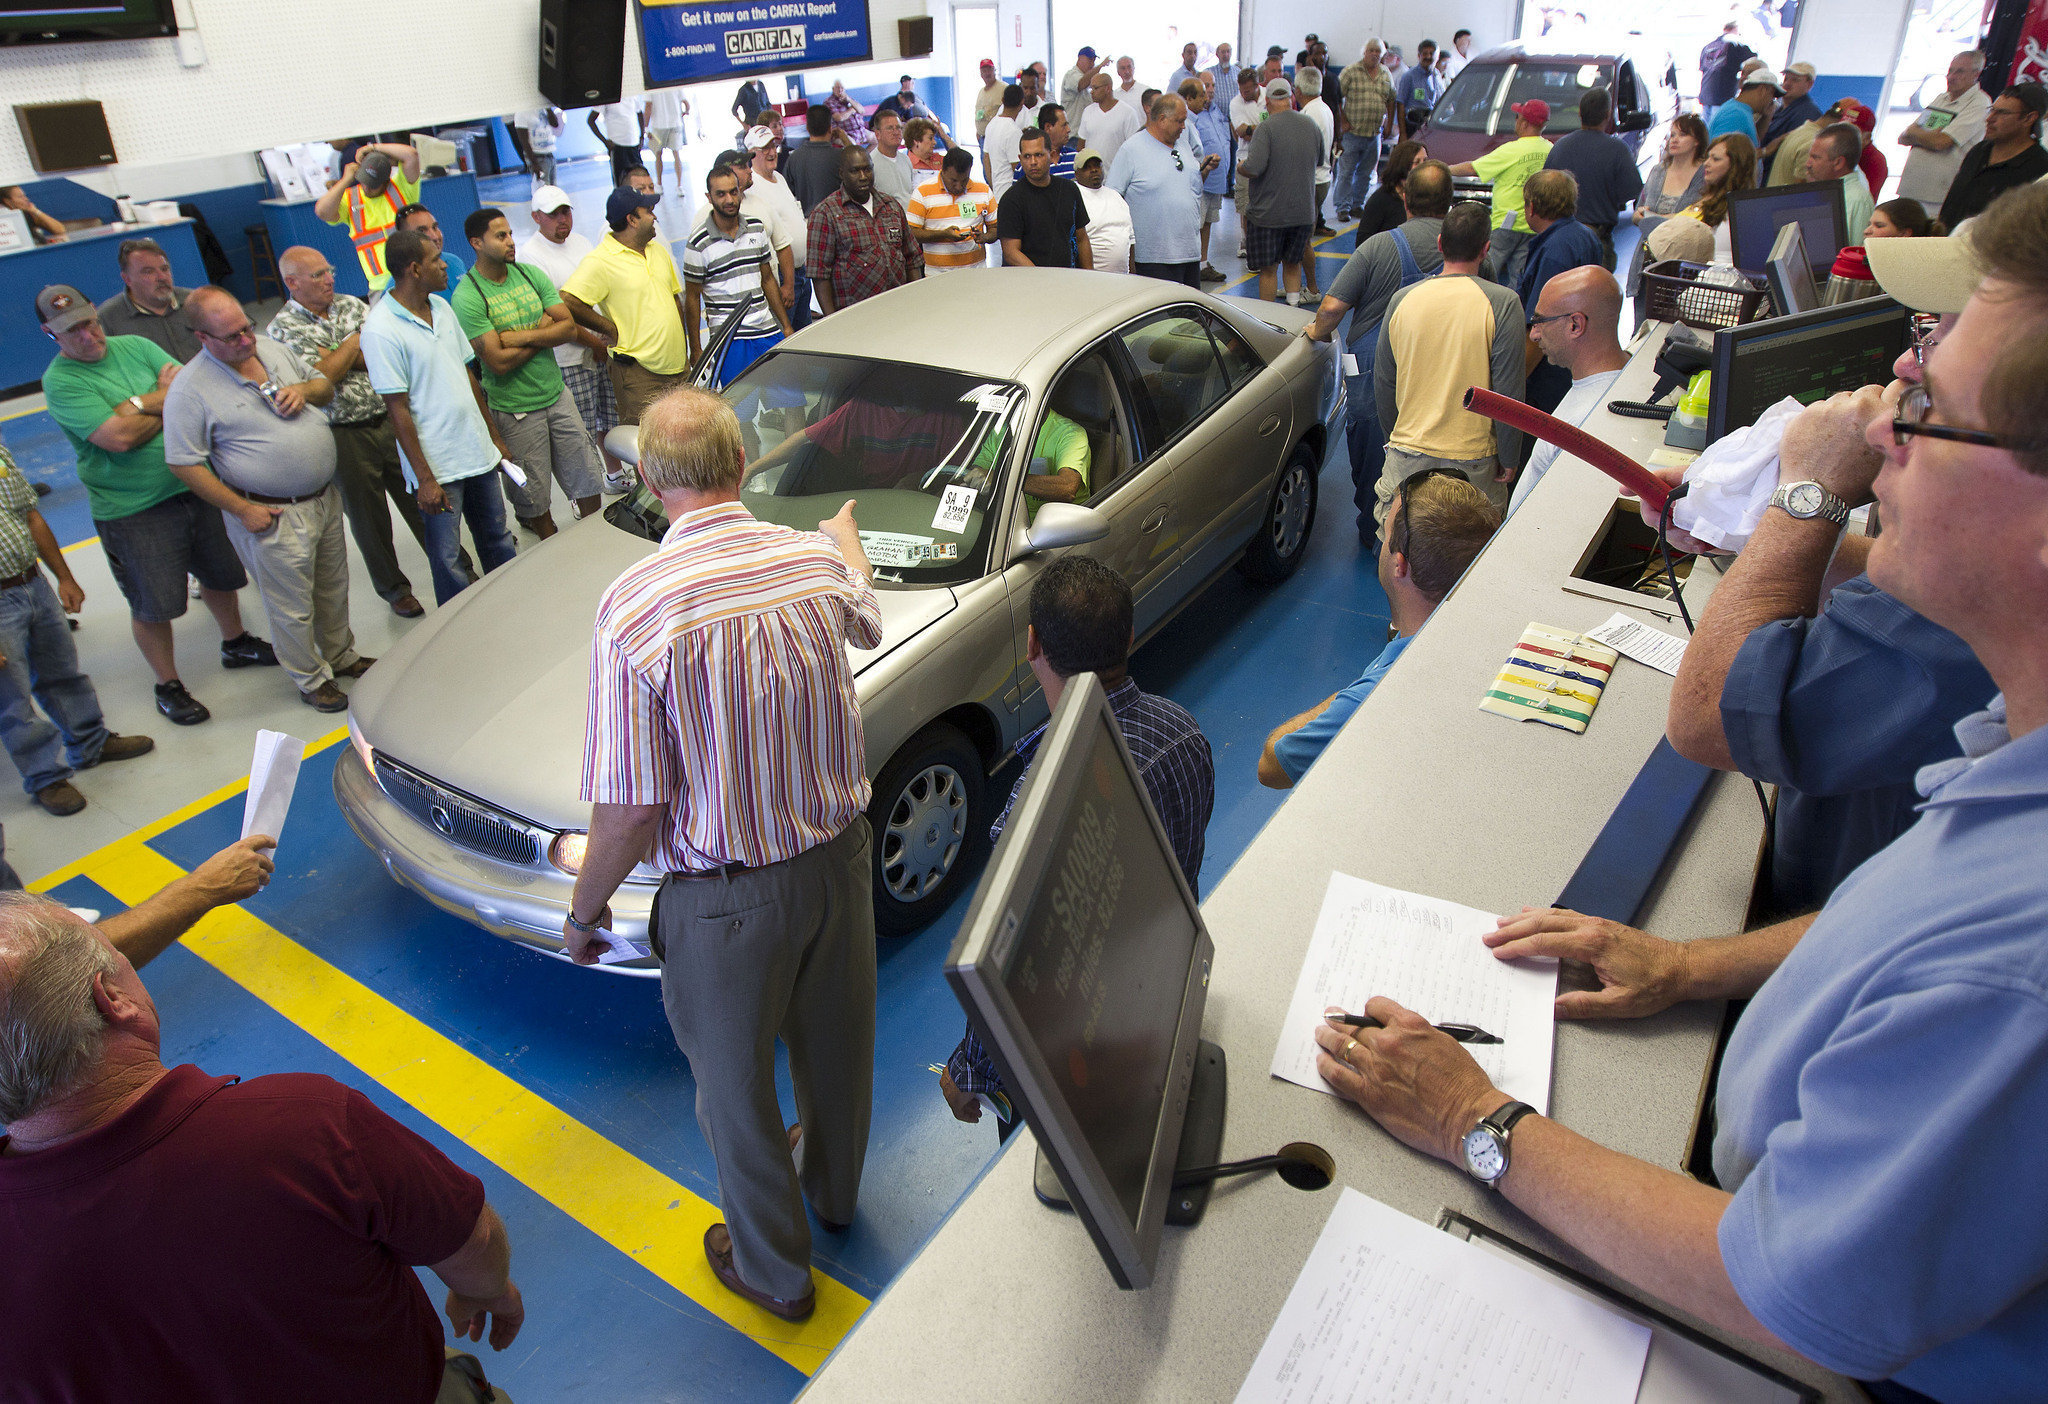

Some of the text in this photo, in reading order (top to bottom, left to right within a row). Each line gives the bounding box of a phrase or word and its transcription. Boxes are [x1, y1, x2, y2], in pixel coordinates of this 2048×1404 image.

[682, 2, 837, 27] Get it now on the CARFAX Report
[727, 29, 803, 54] CARFAX
[814, 29, 858, 41] carfaxonline.com
[665, 43, 716, 58] 1-800-FIND-VIN
[730, 51, 805, 65] VEHICLE HISTORY REPORTS
[946, 491, 971, 508] SA 9
[947, 505, 969, 516] 1999
[866, 546, 906, 555] GRAHAM
[867, 550, 898, 560] MOTOR
[948, 544, 957, 556] 13
[1053, 801, 1101, 932] SA0009
